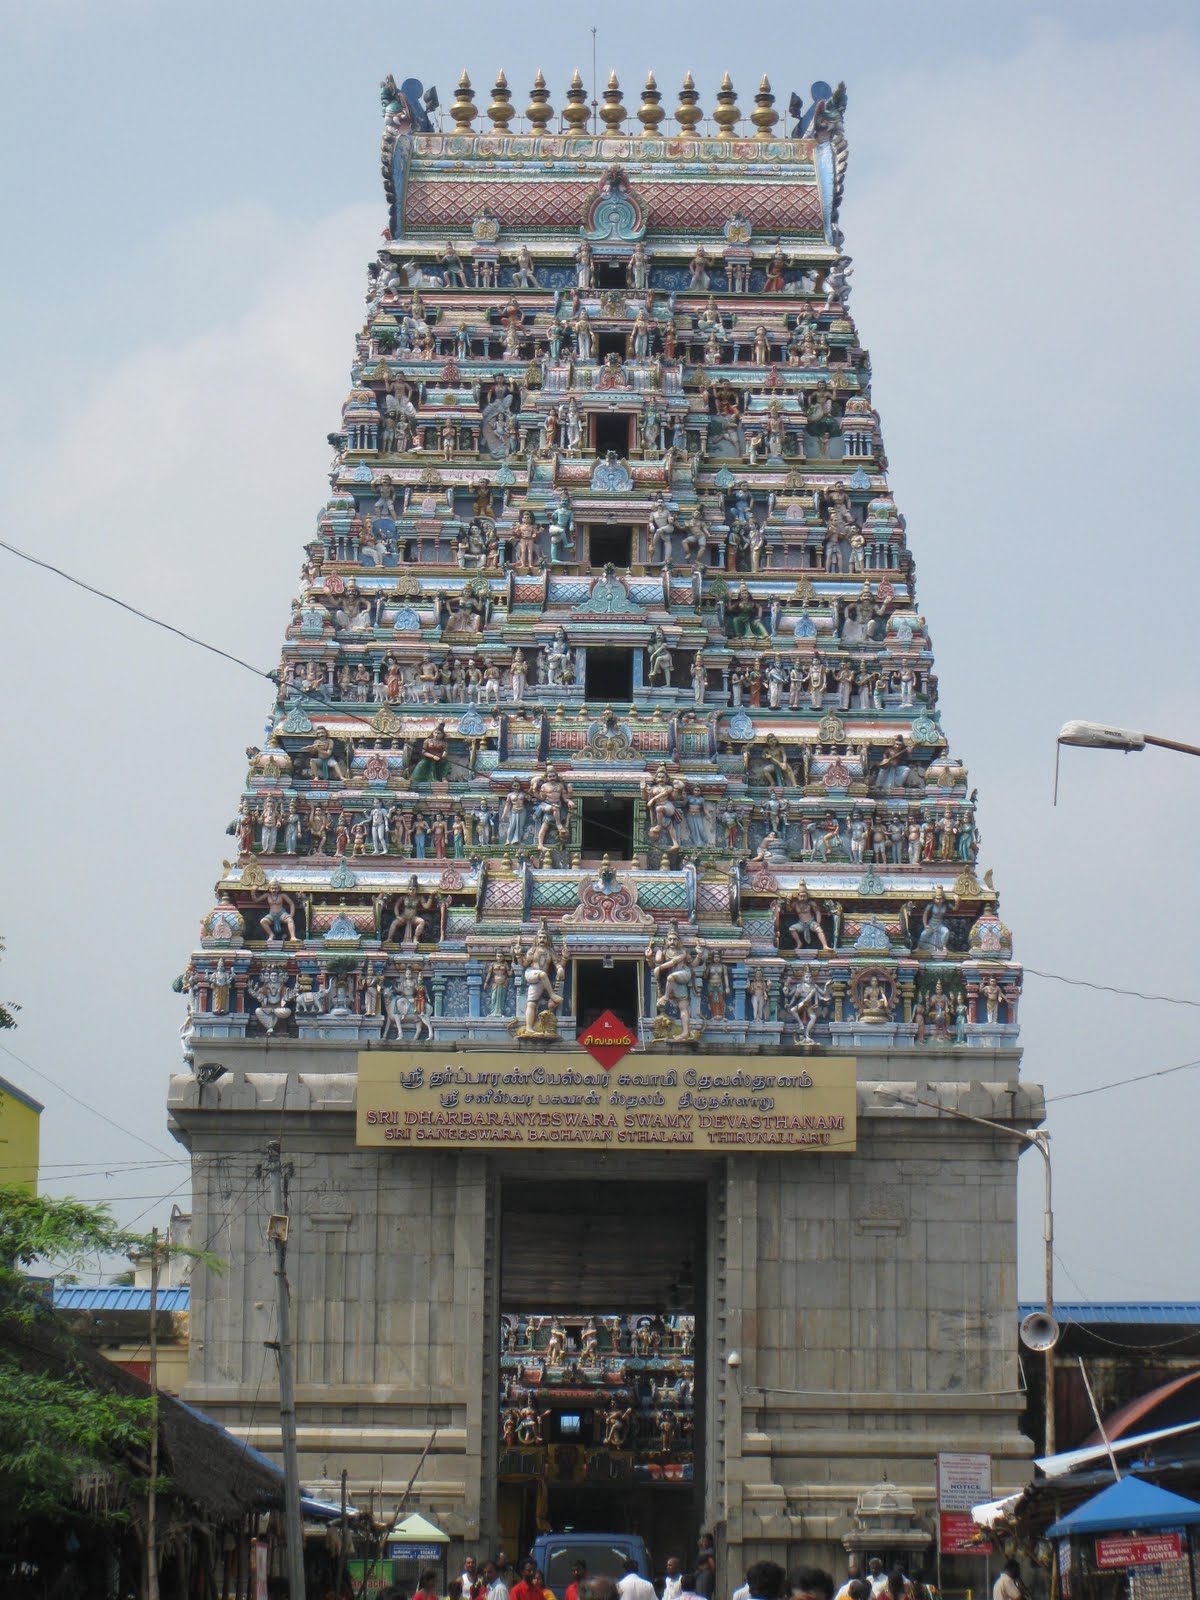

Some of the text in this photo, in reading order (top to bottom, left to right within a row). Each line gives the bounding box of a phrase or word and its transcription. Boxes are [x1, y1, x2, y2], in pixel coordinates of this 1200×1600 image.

[584, 1034, 631, 1046] சிவமயம்
[429, 1065, 611, 1089] தர்ப்பாரண்யேஸ்வர
[618, 1068, 678, 1087] சுவாமி
[682, 1068, 813, 1092] தேவஸ்தானம்
[464, 1088, 534, 1107] சனீஸ்வர
[538, 1089, 602, 1106] பகவான்
[608, 1089, 665, 1110] ஸ்தலம்
[678, 1091, 775, 1111] திருநள்ளாறு
[366, 1110, 845, 1130] SRI DHARBARANYESWARA SWAMY DEVASTHANAM
[385, 1128, 831, 1145] SRI SANEESWARA BAGHAVAN STHALAM THIRUNALLARU
[1142, 1551, 1178, 1561] COUNTER
[1146, 1543, 1173, 1552] TICKET
